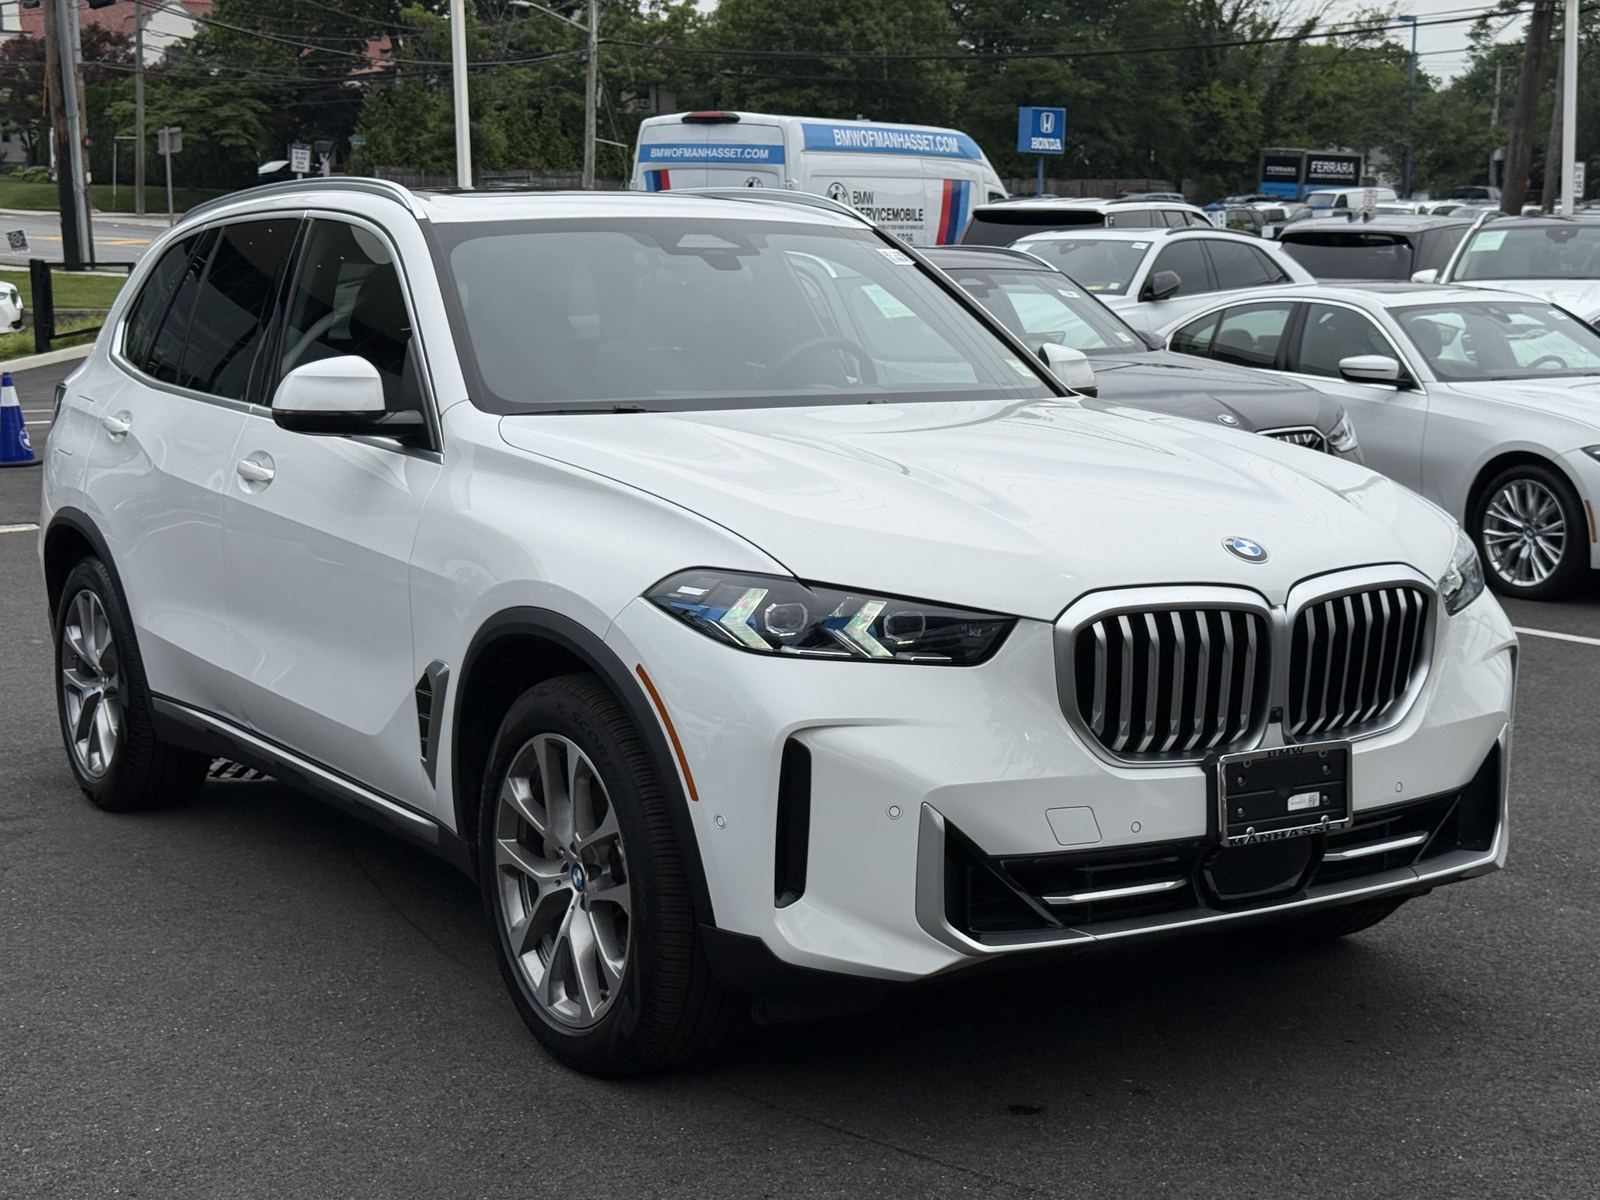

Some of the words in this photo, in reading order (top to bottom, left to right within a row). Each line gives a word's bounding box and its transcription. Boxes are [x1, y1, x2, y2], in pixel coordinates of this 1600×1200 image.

[833, 129, 959, 153] BMWOFMANHASSET.COM
[1031, 137, 1062, 151] HONDA
[650, 148, 769, 160] BMWOFMANHASSET.COM
[1310, 161, 1355, 174] FERRARA
[853, 191, 874, 205] BMW
[1267, 747, 1304, 757] BMW
[1229, 822, 1347, 846] MANHASSET
